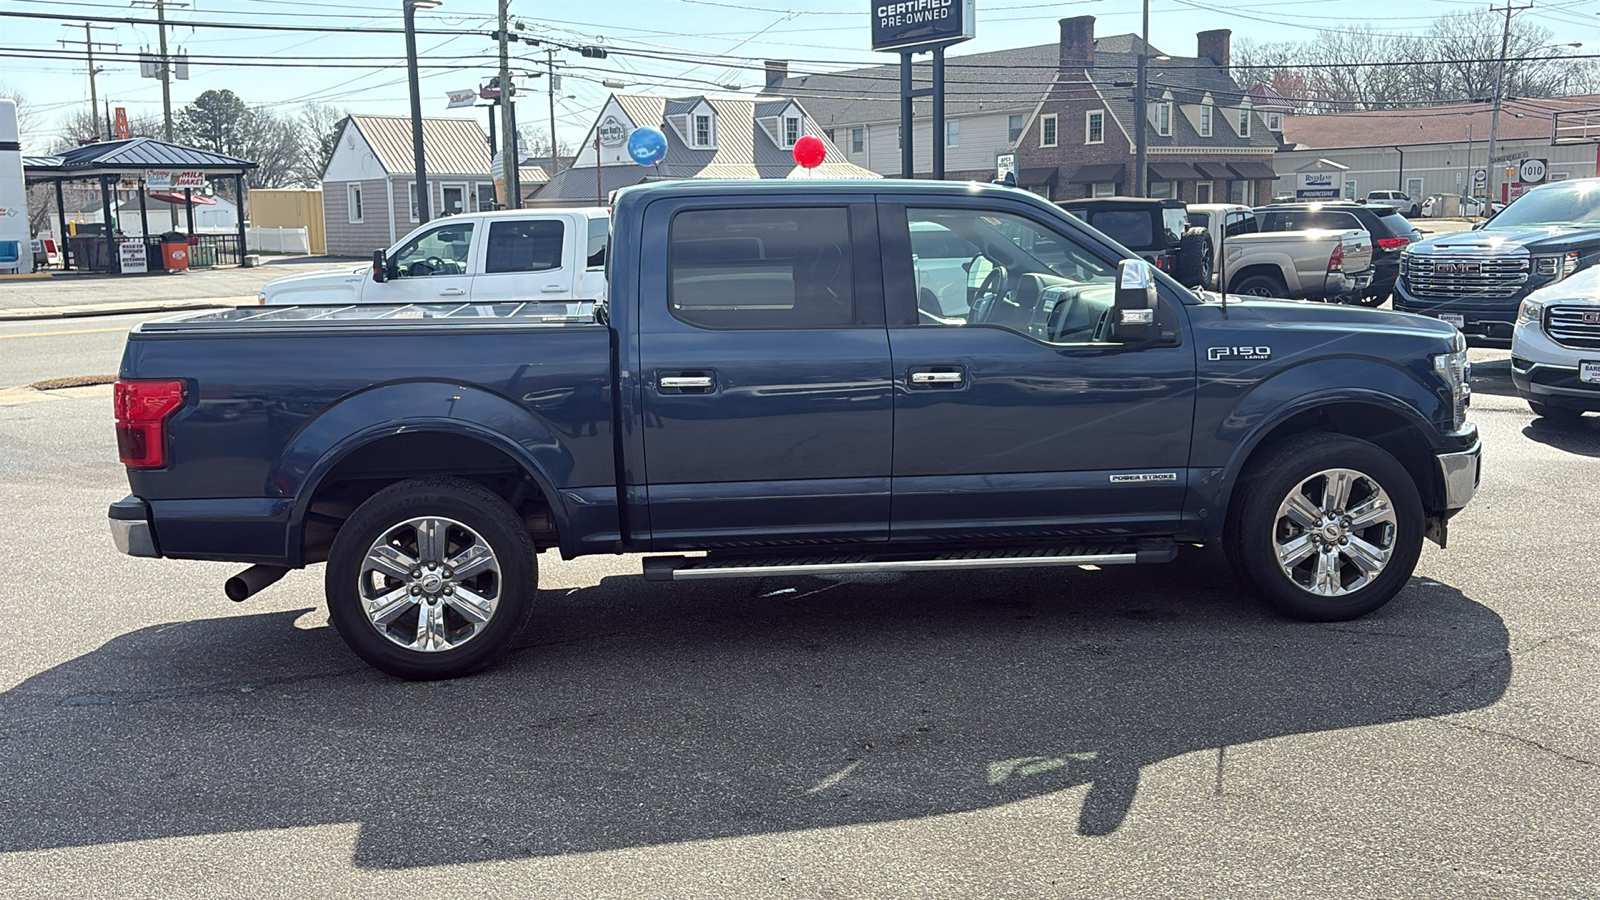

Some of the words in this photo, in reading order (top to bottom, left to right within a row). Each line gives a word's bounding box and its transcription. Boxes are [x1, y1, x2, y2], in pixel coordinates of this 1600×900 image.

[878, 0, 952, 17] CERTIFIED
[881, 8, 948, 28] PRE-OWNED
[1524, 166, 1542, 176] 1010
[1436, 263, 1479, 273] GMC
